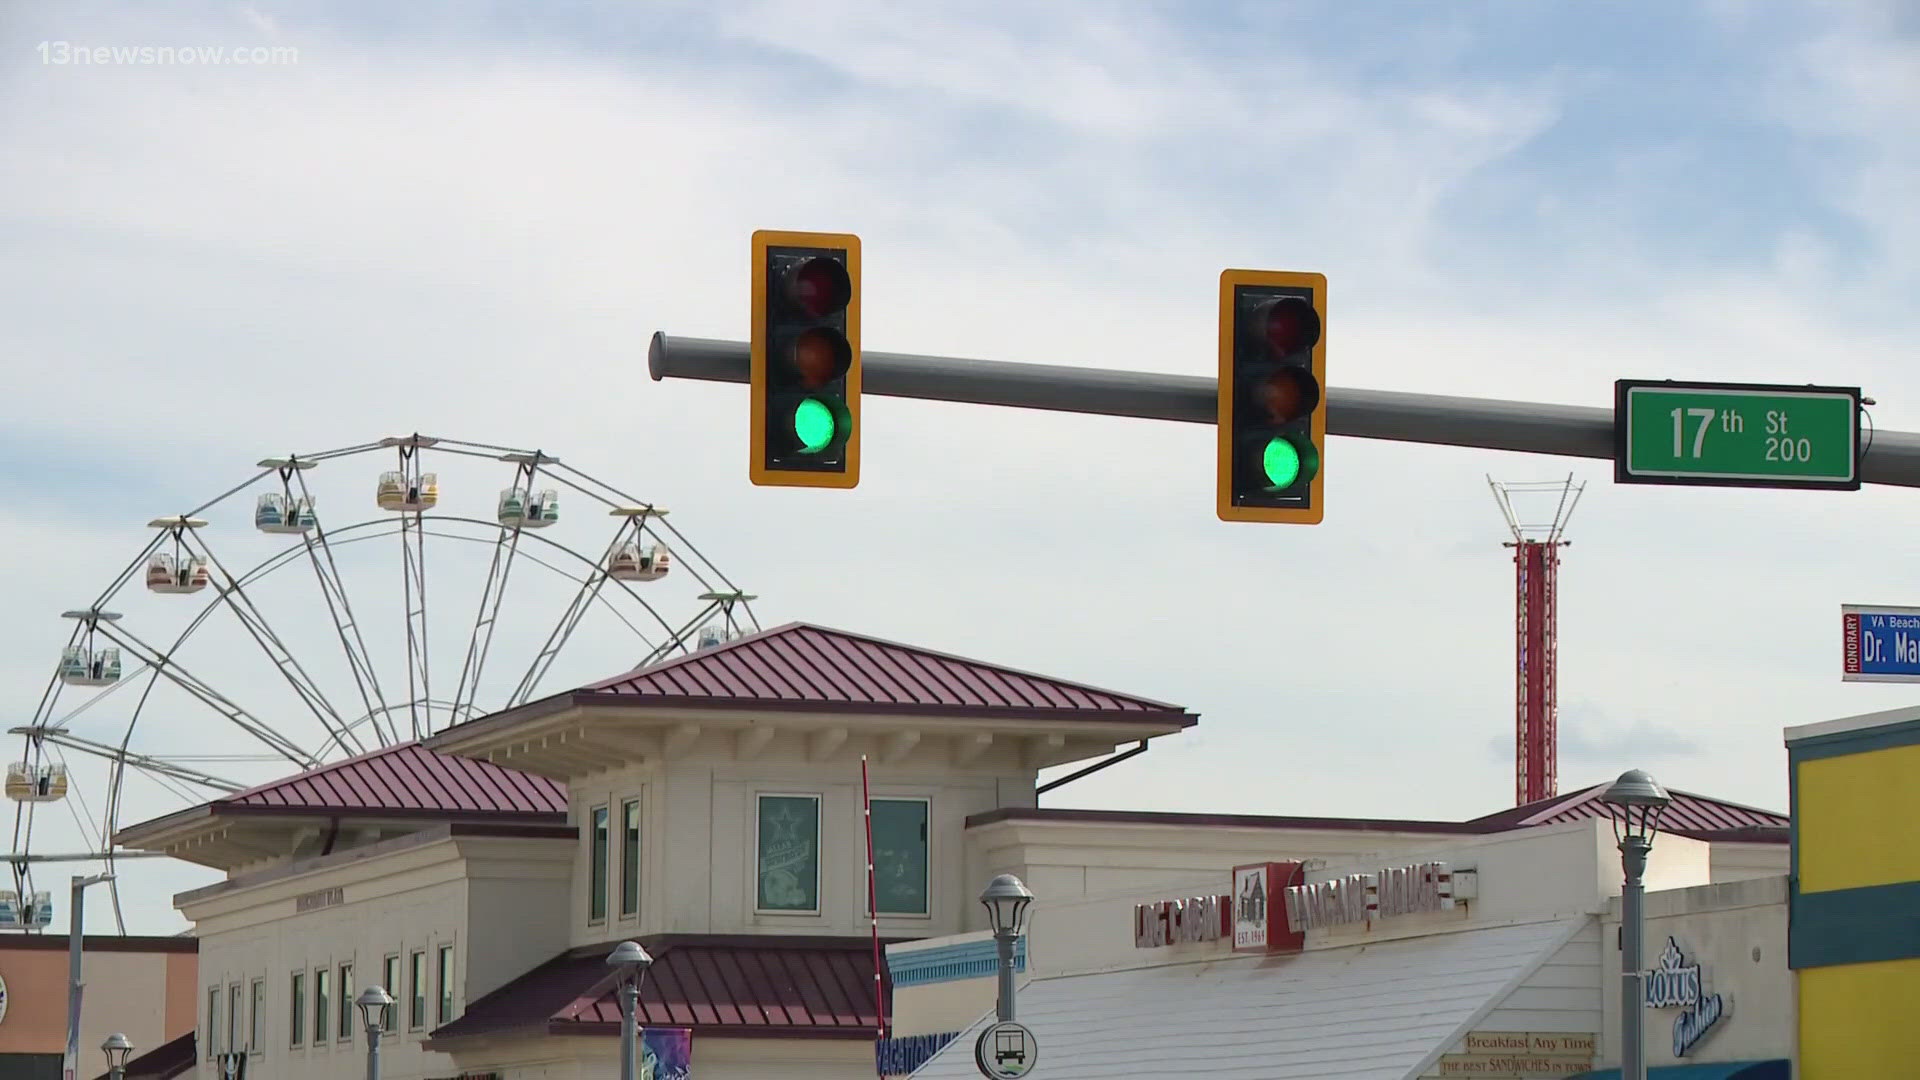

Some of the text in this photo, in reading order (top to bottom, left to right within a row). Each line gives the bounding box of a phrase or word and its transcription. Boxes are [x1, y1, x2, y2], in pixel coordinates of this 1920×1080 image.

[1670, 407, 1788, 459] 17th St
[1765, 437, 1811, 462] 200
[1871, 616, 1920, 629] VA Beach
[1846, 616, 1858, 672] HONORARY
[1864, 630, 1920, 664] Dr. Ma
[1251, 929, 1265, 943] 1969
[1645, 970, 1698, 1004] LOTUS
[1467, 1036, 1593, 1050] Breakfast Any Time
[1442, 1058, 1592, 1073] THE BEST SANDWICHES IN TOWN
